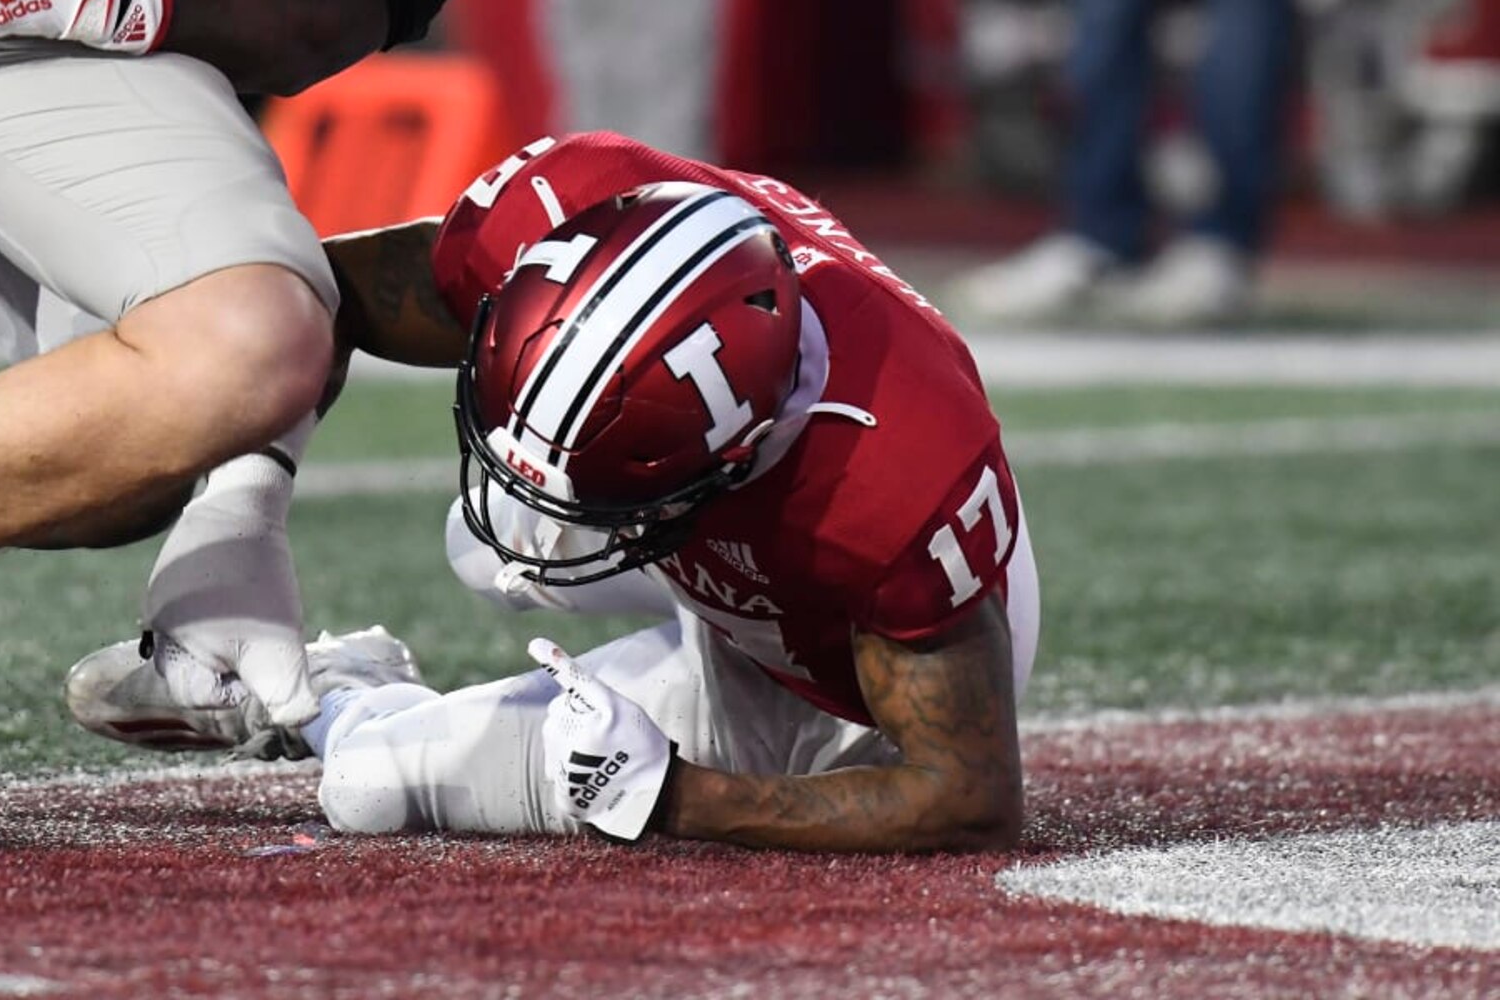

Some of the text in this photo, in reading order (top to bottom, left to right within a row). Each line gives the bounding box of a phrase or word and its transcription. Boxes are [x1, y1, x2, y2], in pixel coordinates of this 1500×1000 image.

[736, 174, 943, 318] HAYNES
[662, 321, 755, 454] I
[506, 449, 547, 488] LEO
[705, 538, 771, 585] adidas
[927, 464, 1013, 610] 17
[575, 751, 630, 810] adidas
